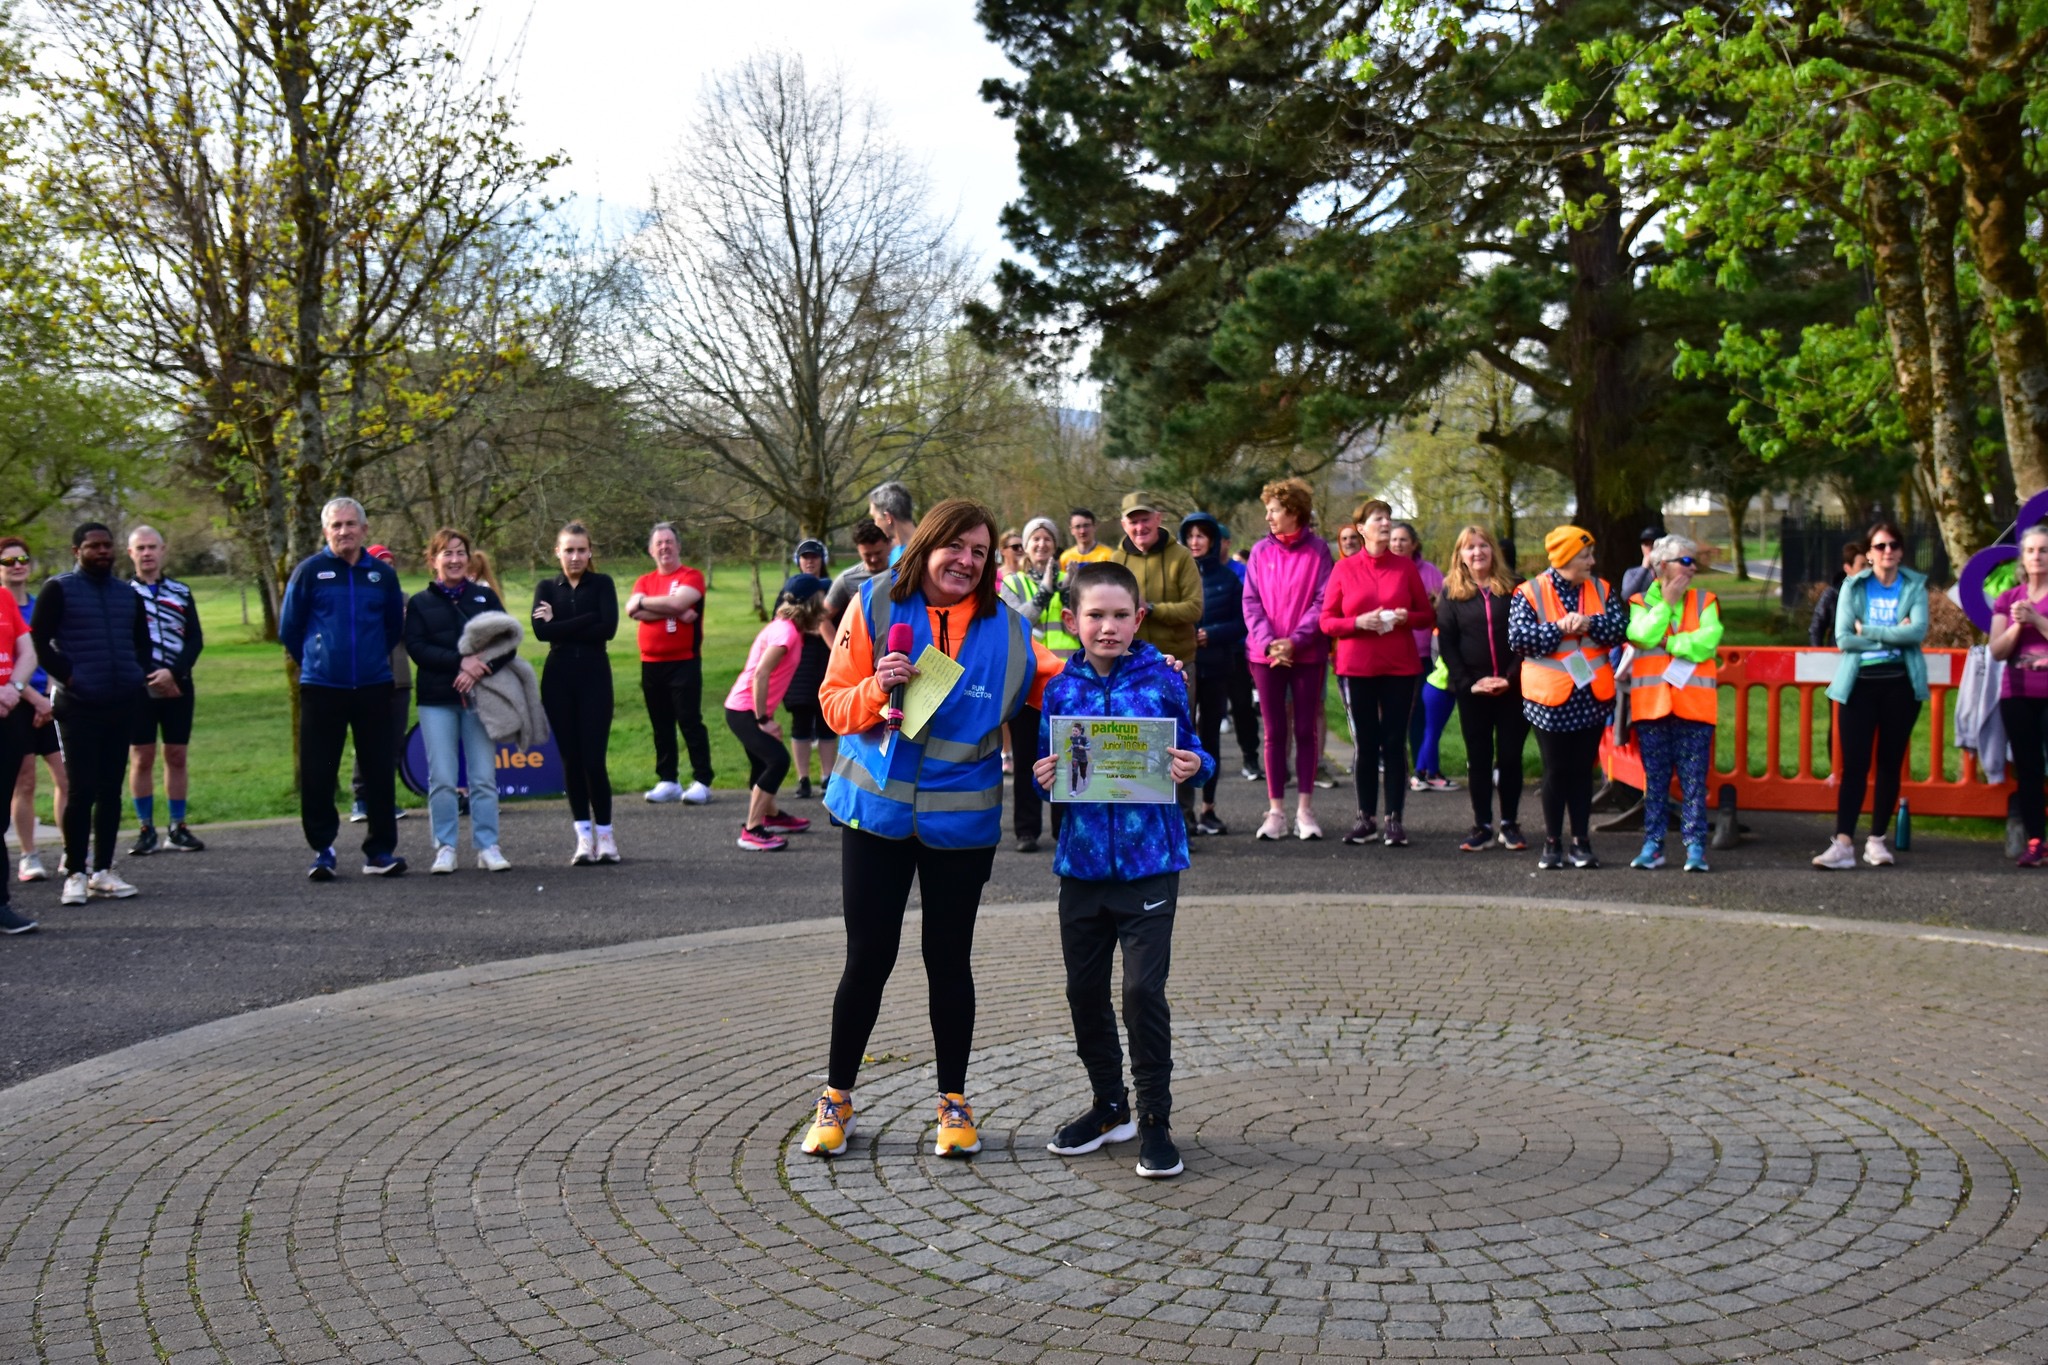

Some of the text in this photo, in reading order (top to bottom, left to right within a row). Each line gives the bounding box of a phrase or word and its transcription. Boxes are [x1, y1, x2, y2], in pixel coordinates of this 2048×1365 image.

[963, 689, 992, 699] DIRECTOR
[1091, 721, 1138, 736] parkrun
[1102, 741, 1148, 750] Junior 10 Club
